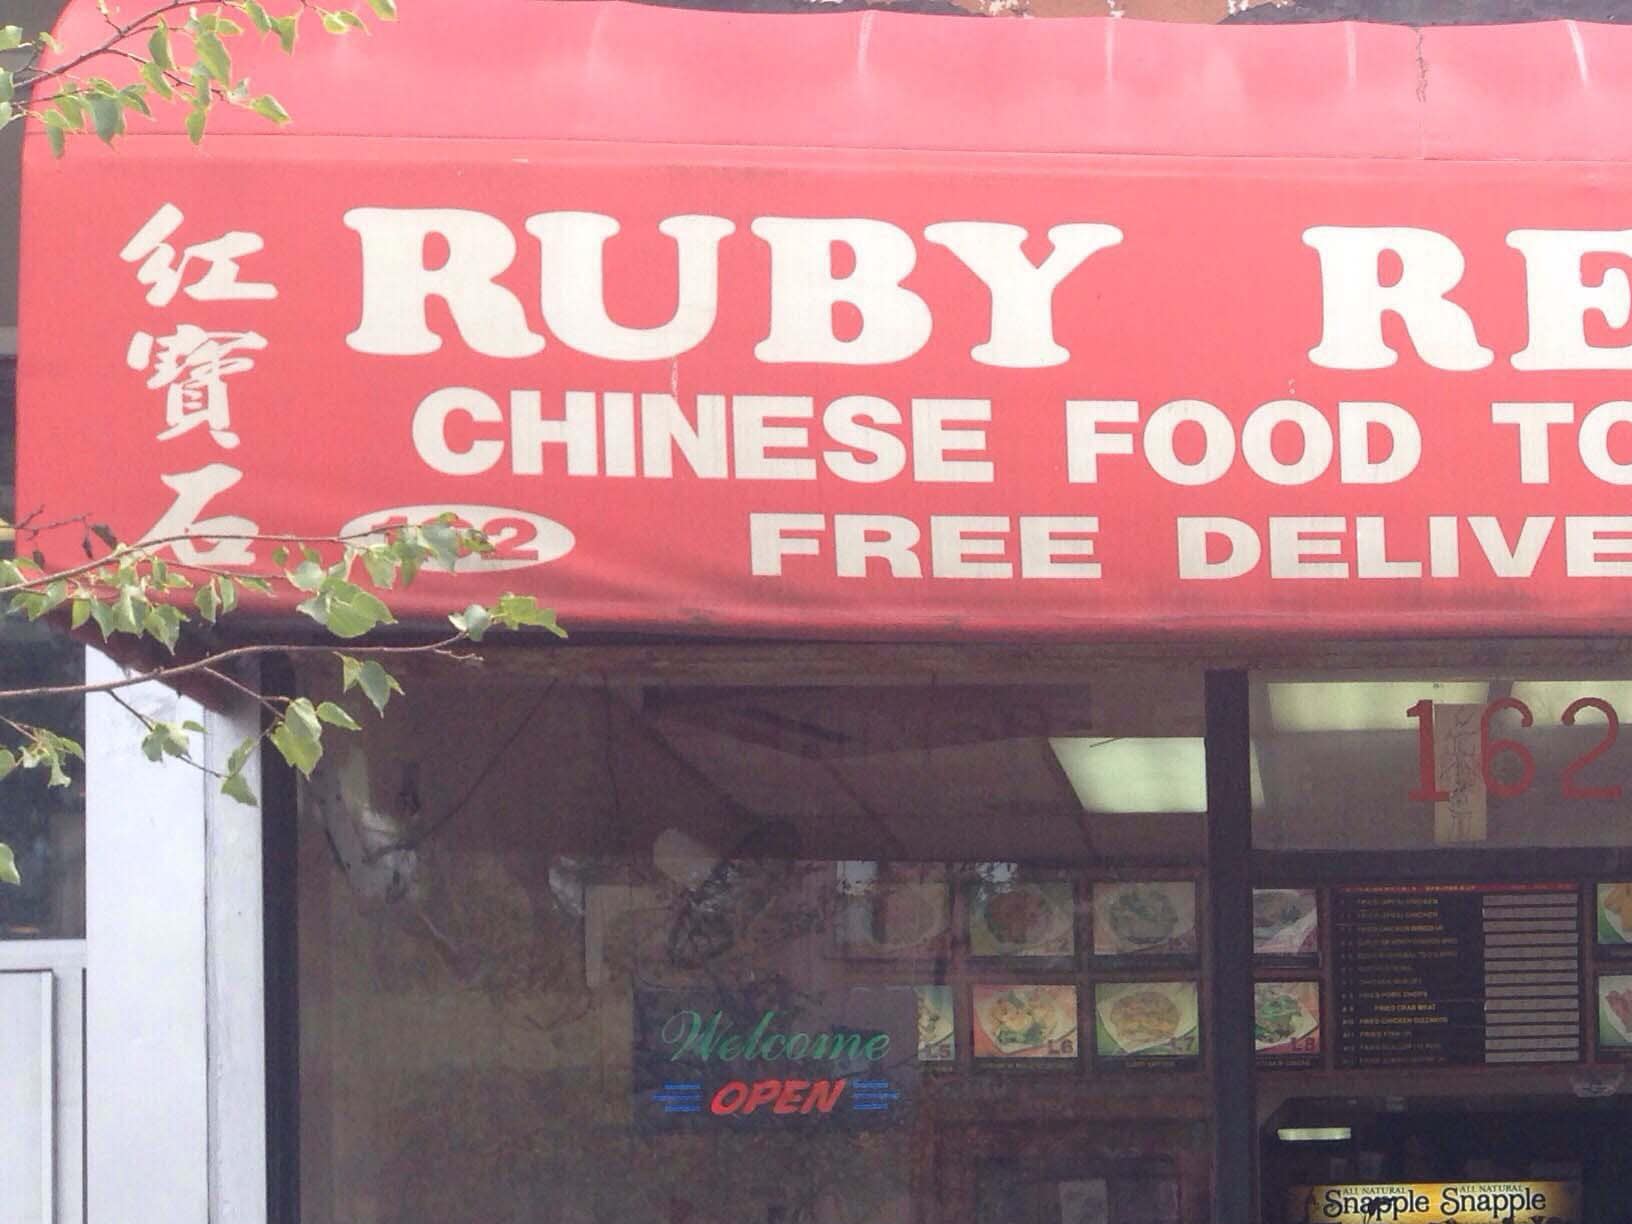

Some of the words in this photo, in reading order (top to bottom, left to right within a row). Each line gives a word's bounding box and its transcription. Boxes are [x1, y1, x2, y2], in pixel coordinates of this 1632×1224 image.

[343, 206, 1124, 369] RUBY
[412, 387, 996, 484] CHINESE
[1065, 399, 1422, 486] FOOD
[749, 513, 1102, 579] FREE
[1406, 697, 1623, 802] 162
[661, 1009, 891, 1063] Welcome
[711, 1078, 849, 1115] OPEN
[1323, 1189, 1430, 1222] Snapple
[1440, 1187, 1546, 1218] Snapple
